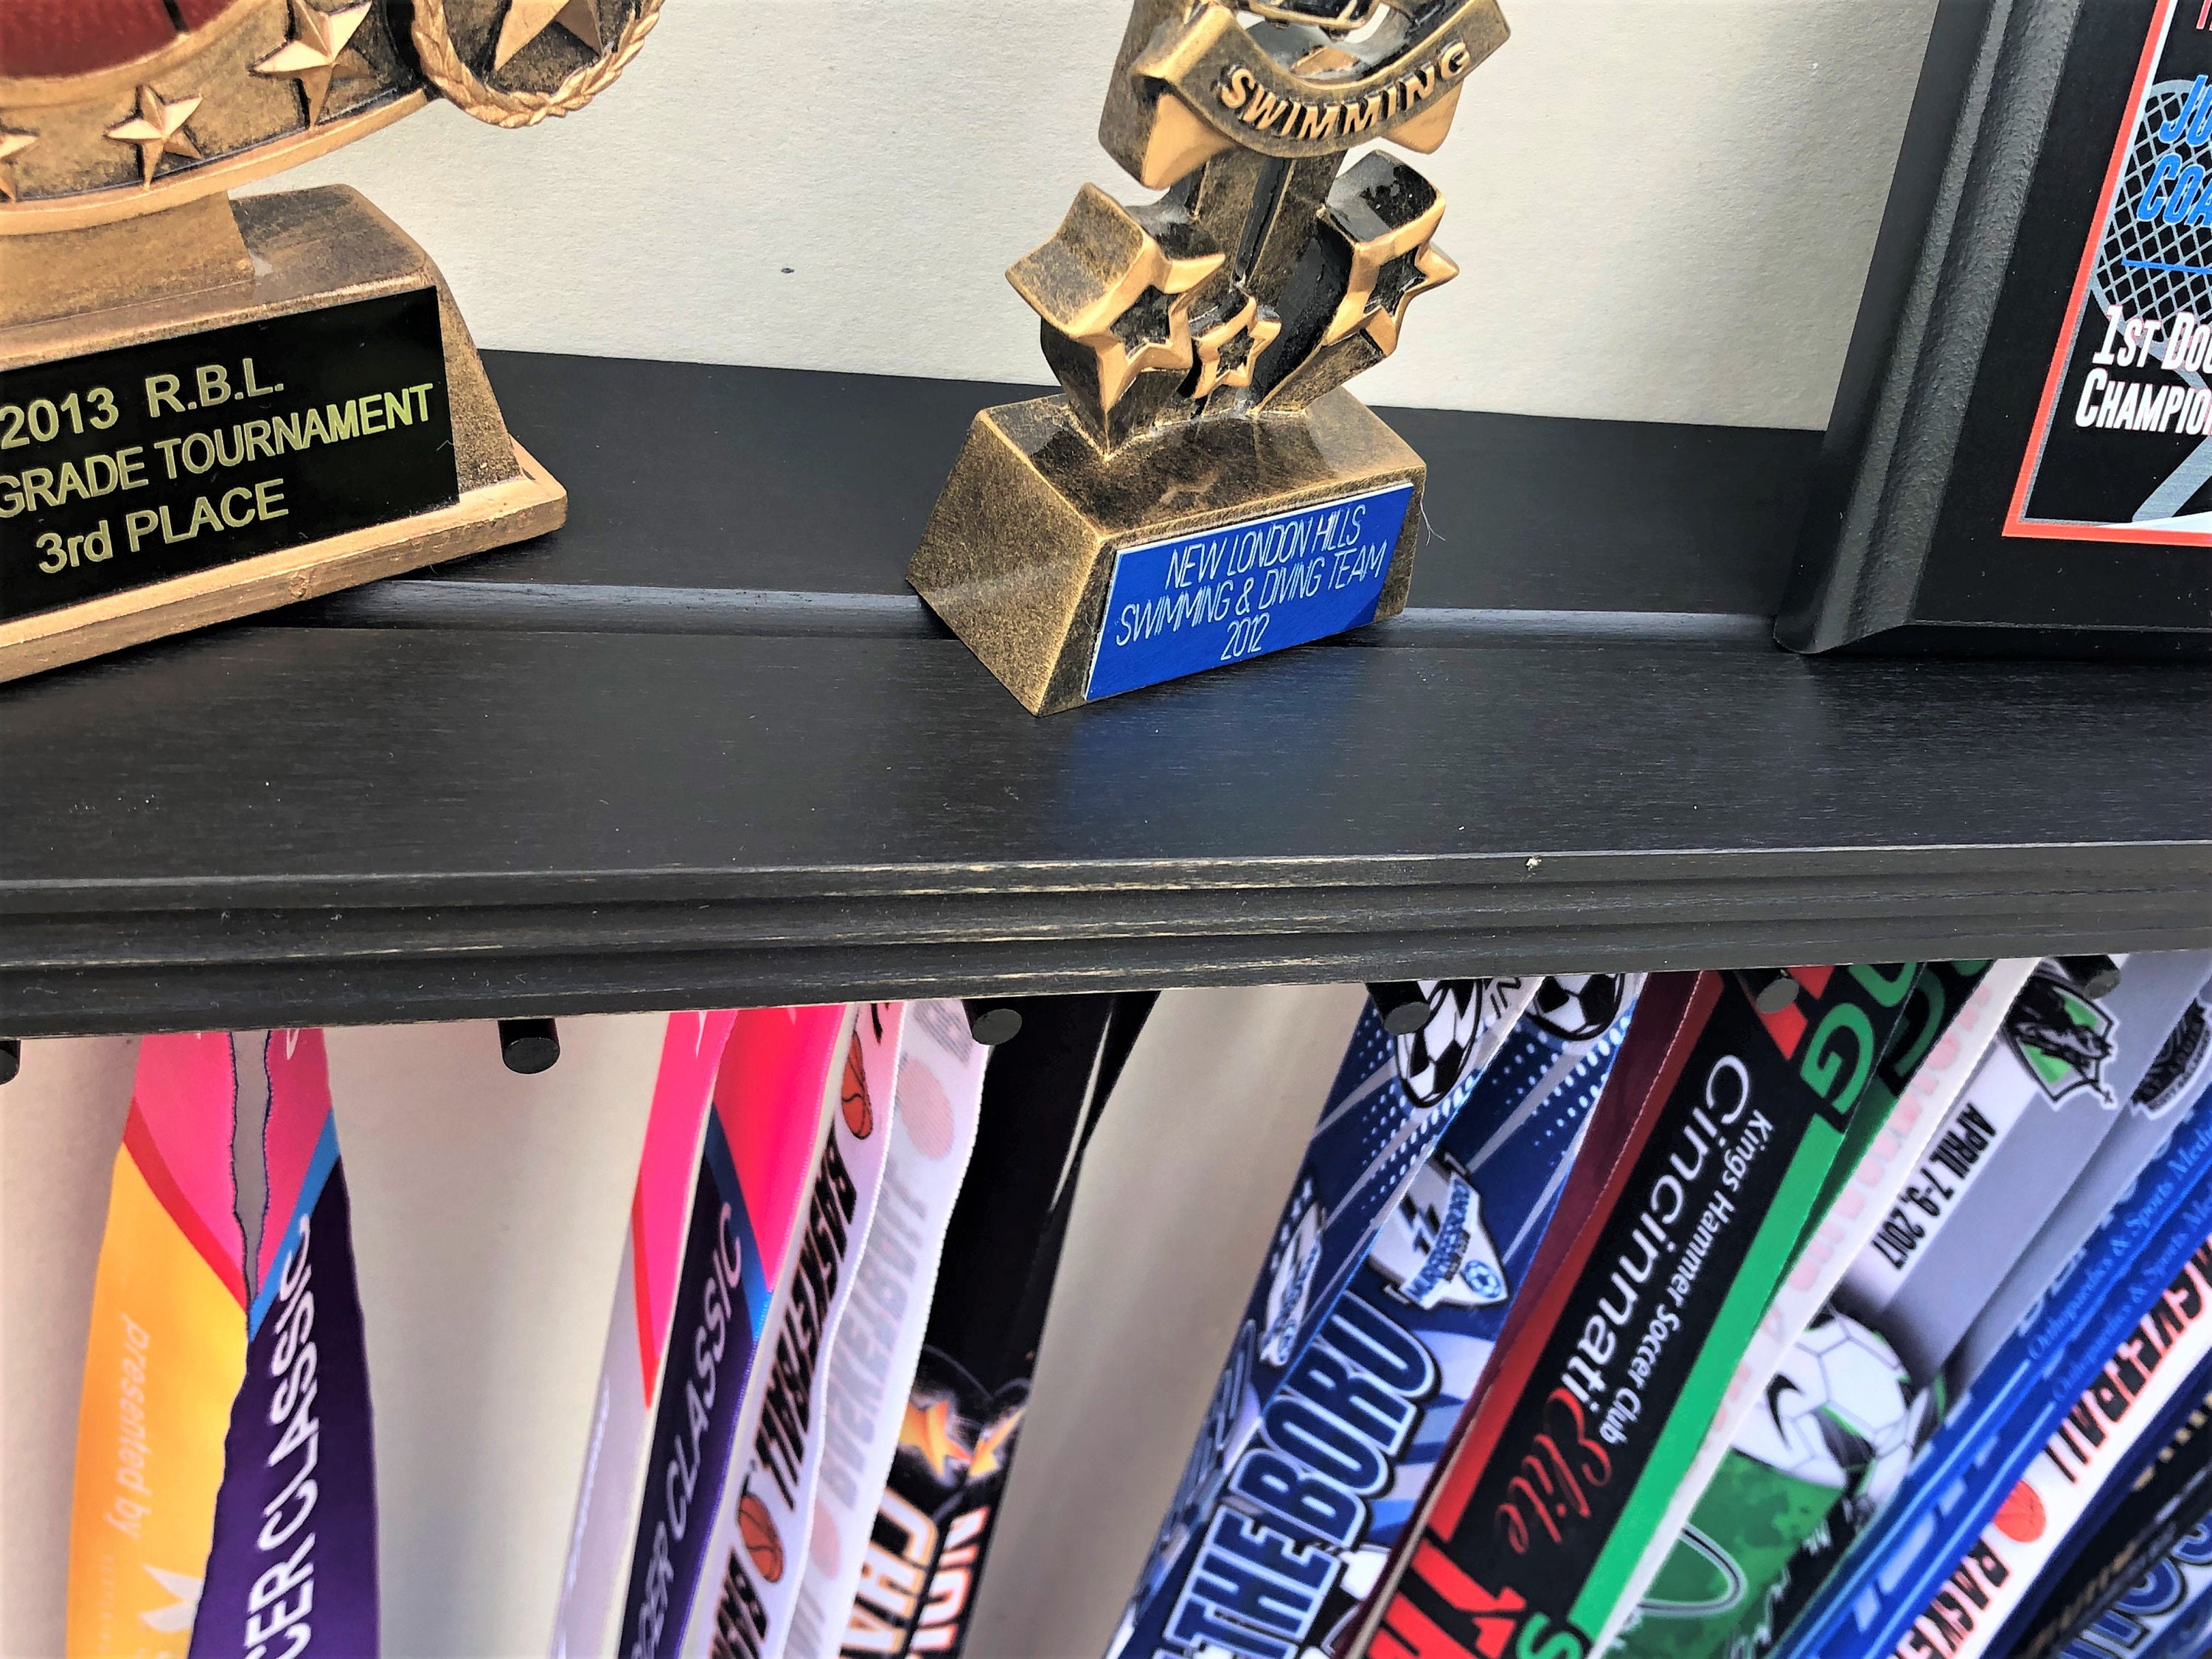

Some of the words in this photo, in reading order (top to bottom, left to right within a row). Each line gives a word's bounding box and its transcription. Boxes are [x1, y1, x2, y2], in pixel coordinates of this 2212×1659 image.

[1218, 37, 1472, 140] SWIMMING
[0, 386, 119, 448] 2013
[145, 357, 285, 418] R.B.L.
[0, 445, 150, 518] GRADE
[153, 382, 434, 480] TOURNAMENT
[35, 518, 114, 574] 3rd
[125, 478, 289, 552] PLACE
[1164, 539, 1229, 590] NEW
[1225, 515, 1314, 577] LONDON
[1315, 503, 1367, 550] HILLS
[1115, 578, 1234, 647] SWIMMING
[1234, 576, 1255, 616] &
[1258, 555, 1324, 610] DIVING
[1326, 538, 1388, 591] TEAM
[1220, 611, 1272, 661] 2012
[1723, 1108, 1774, 1192] Kings
[1929, 1102, 1997, 1181] APRIL
[1559, 1054, 1751, 1414] Cincinnati
[1870, 1208, 1927, 1272] 2017
[1901, 1167, 1956, 1219] 7-9,
[1664, 1189, 1736, 1309] Hammer
[753, 1115, 857, 1513] BASKETBALL
[1627, 1302, 1681, 1389] Soccer
[114, 1312, 152, 1498] presented
[256, 1213, 320, 1551] CLASSIC
[664, 1201, 742, 1542] CLASSIC
[1598, 1386, 1643, 1444] Club
[104, 1495, 153, 1540] by
[1495, 1387, 1613, 1554] Elite
